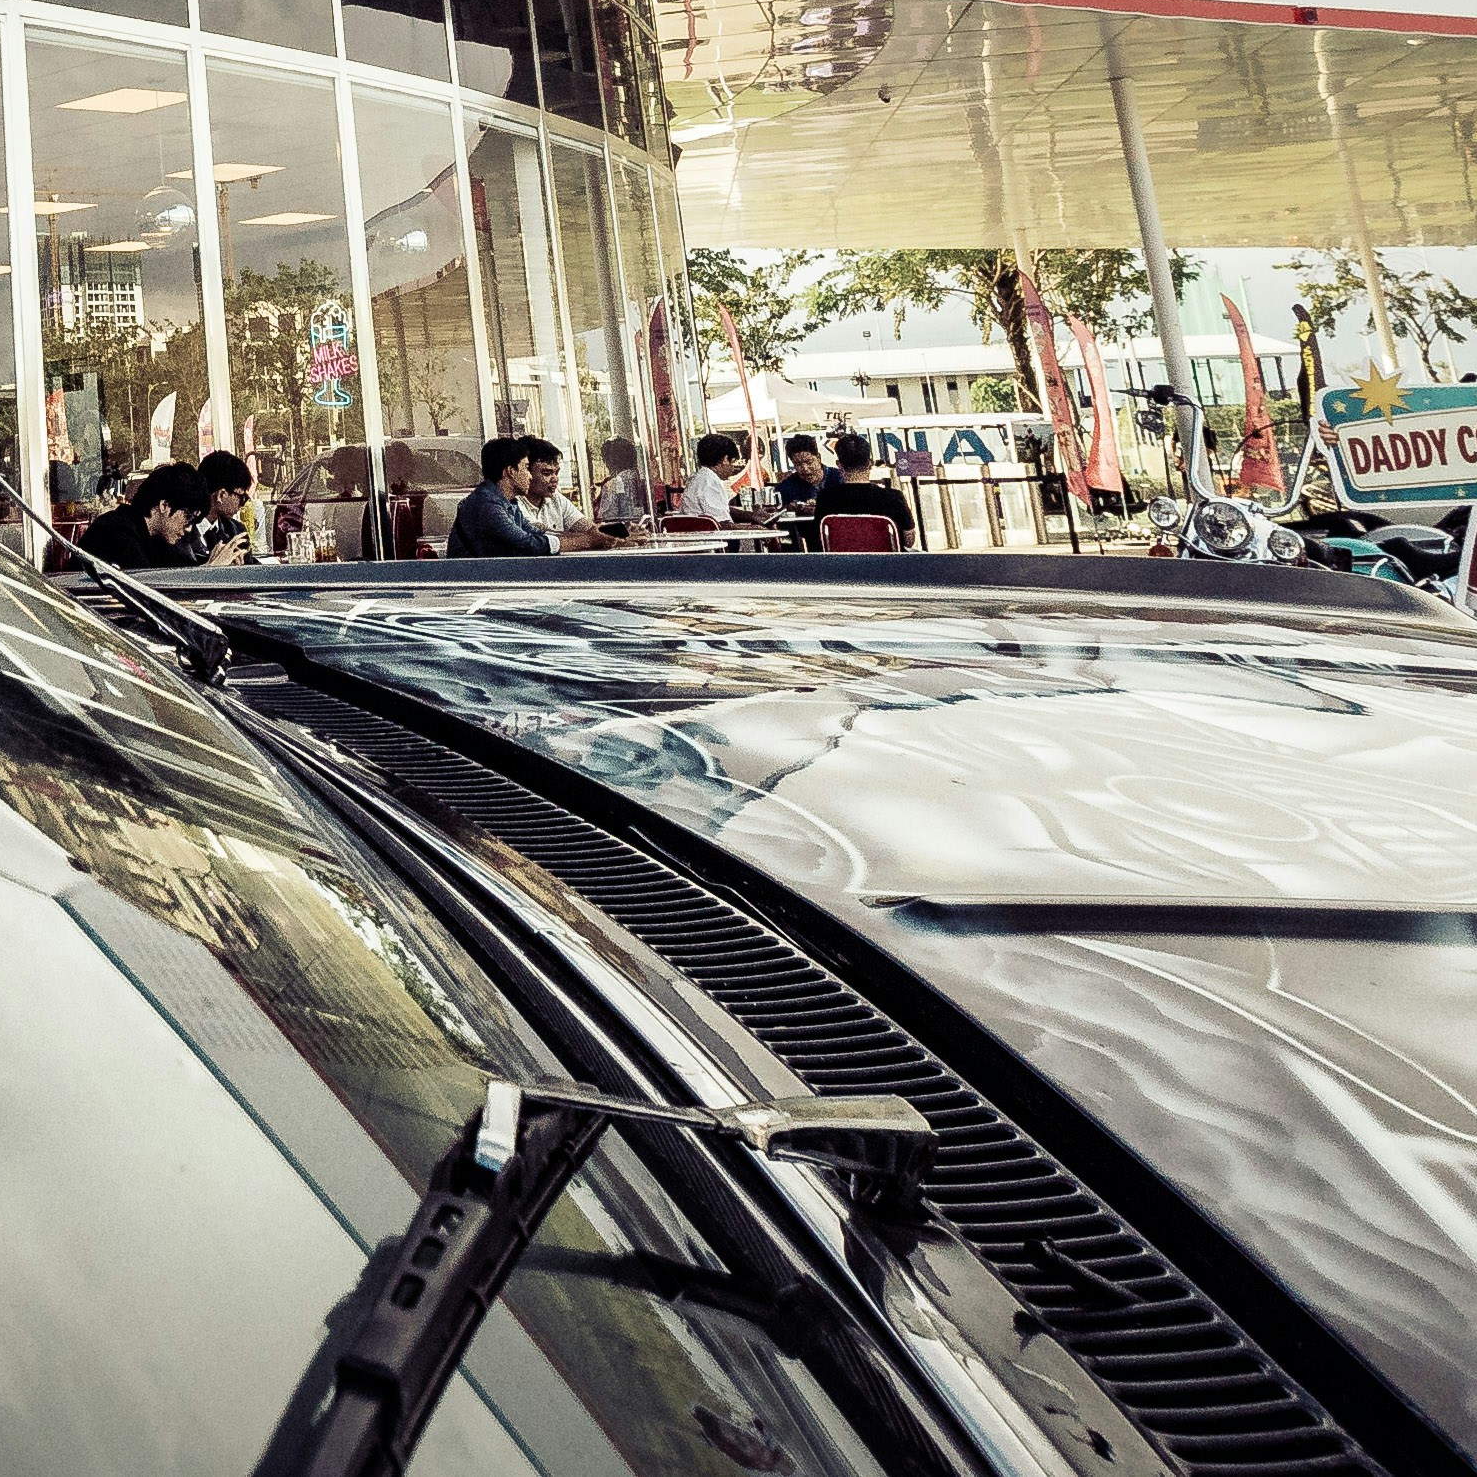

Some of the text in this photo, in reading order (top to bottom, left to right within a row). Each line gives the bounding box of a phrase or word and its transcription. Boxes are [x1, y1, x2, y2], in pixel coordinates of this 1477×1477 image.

[312, 342, 344, 365] MILK
[310, 354, 358, 383] SHAKES
[1346, 427, 1449, 476] DADDY
